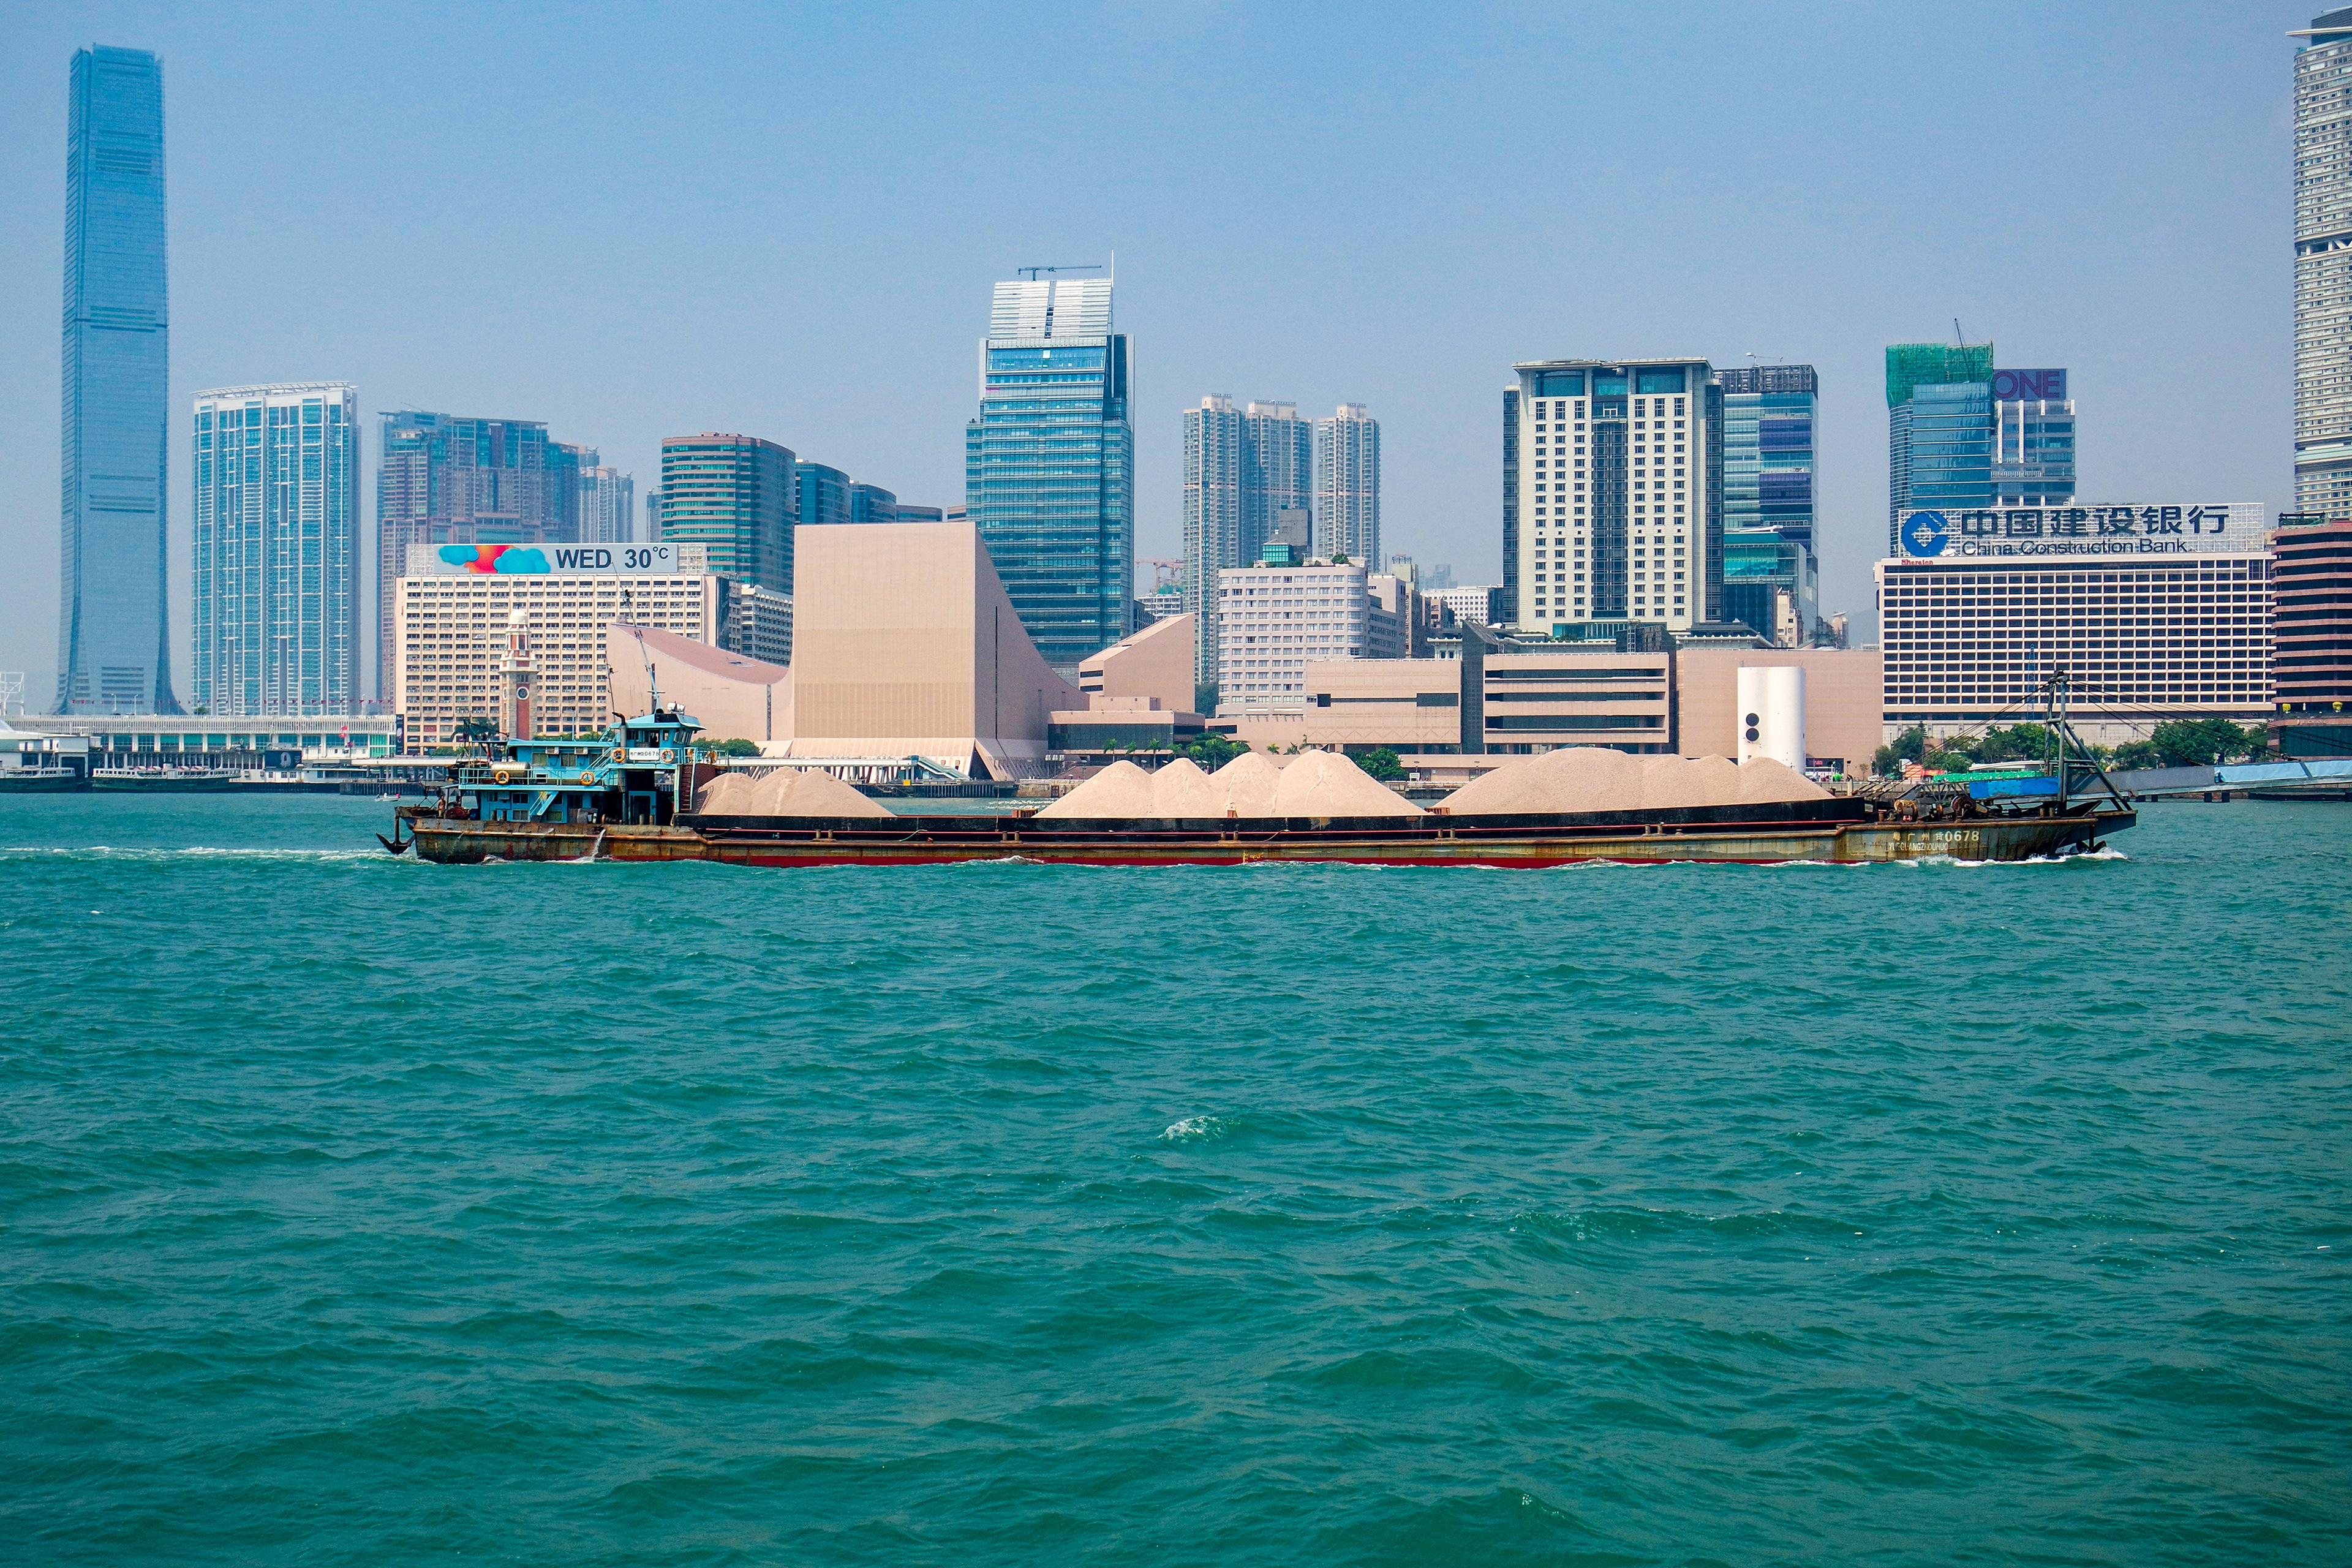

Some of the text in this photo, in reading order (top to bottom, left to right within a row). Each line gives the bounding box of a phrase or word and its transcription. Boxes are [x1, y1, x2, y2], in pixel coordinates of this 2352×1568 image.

[1993, 371, 2060, 399] ONE
[1961, 505, 2230, 537] 中国建设银行
[1962, 538, 2187, 555] China Construction Bank
[555, 549, 612, 569] WED
